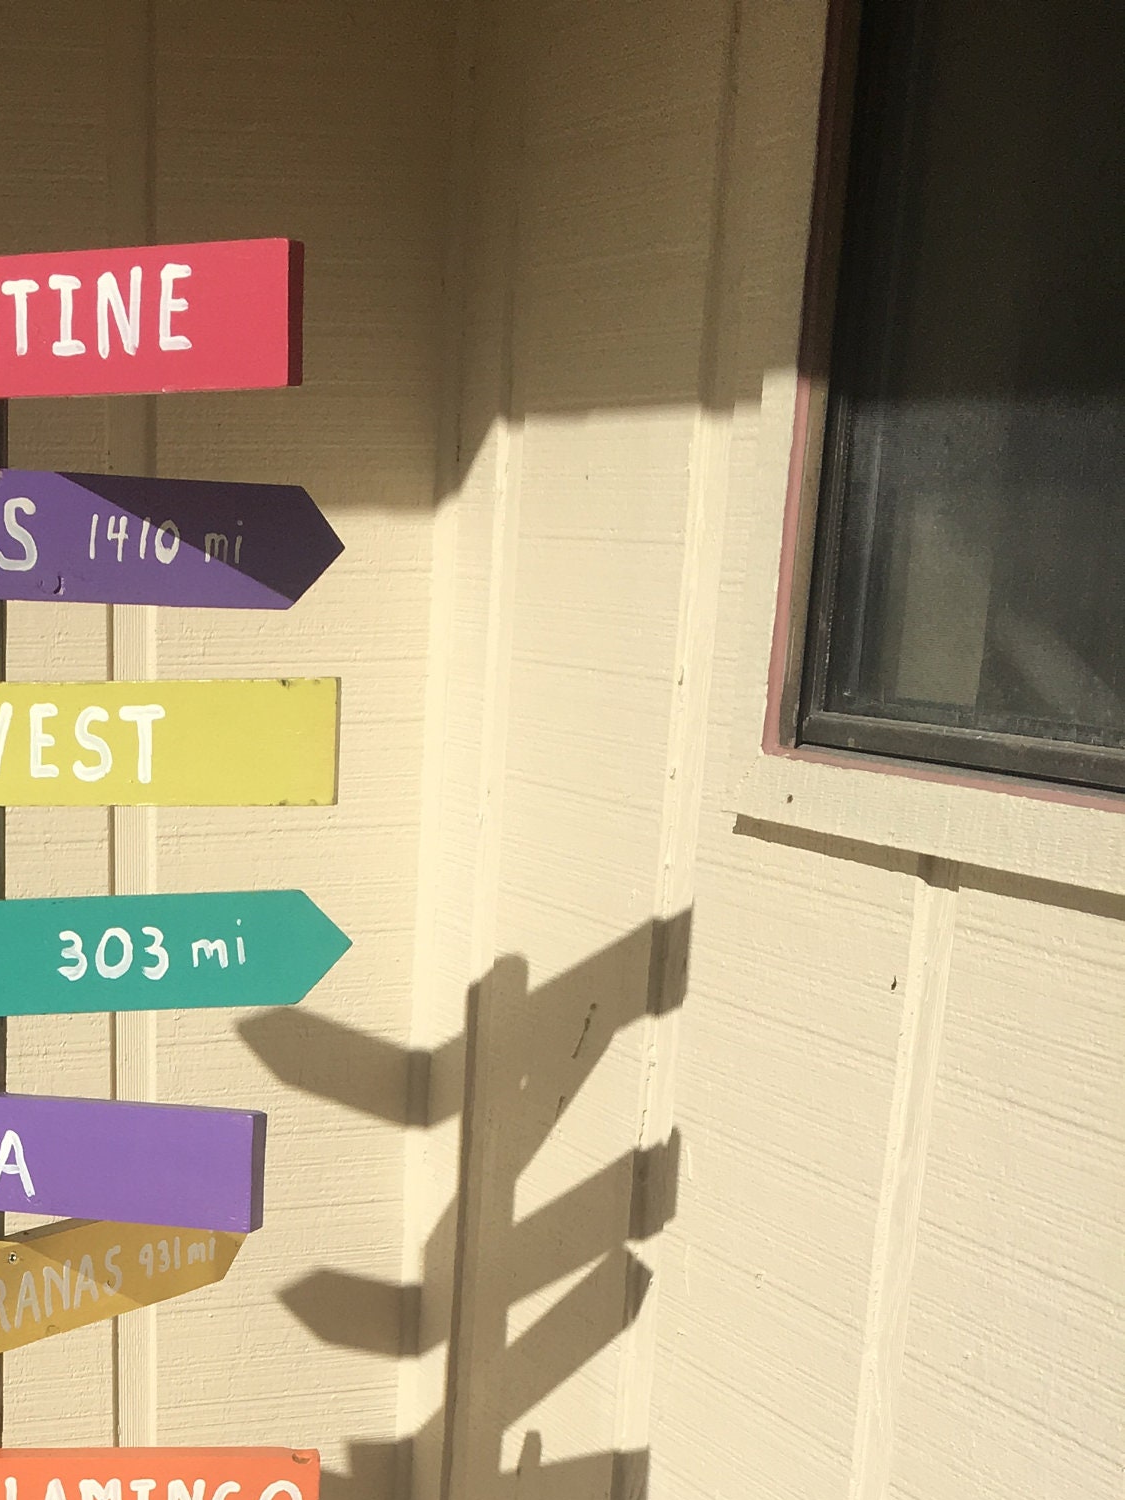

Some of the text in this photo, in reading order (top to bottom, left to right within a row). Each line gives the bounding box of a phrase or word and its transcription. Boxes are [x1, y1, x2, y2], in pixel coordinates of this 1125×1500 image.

[87, 512, 180, 564] 1410
[204, 519, 244, 563] mi
[57, 925, 170, 981] 303
[191, 918, 248, 969] mi
[138, 1236, 181, 1278] 931
[187, 1229, 216, 1265] mi
